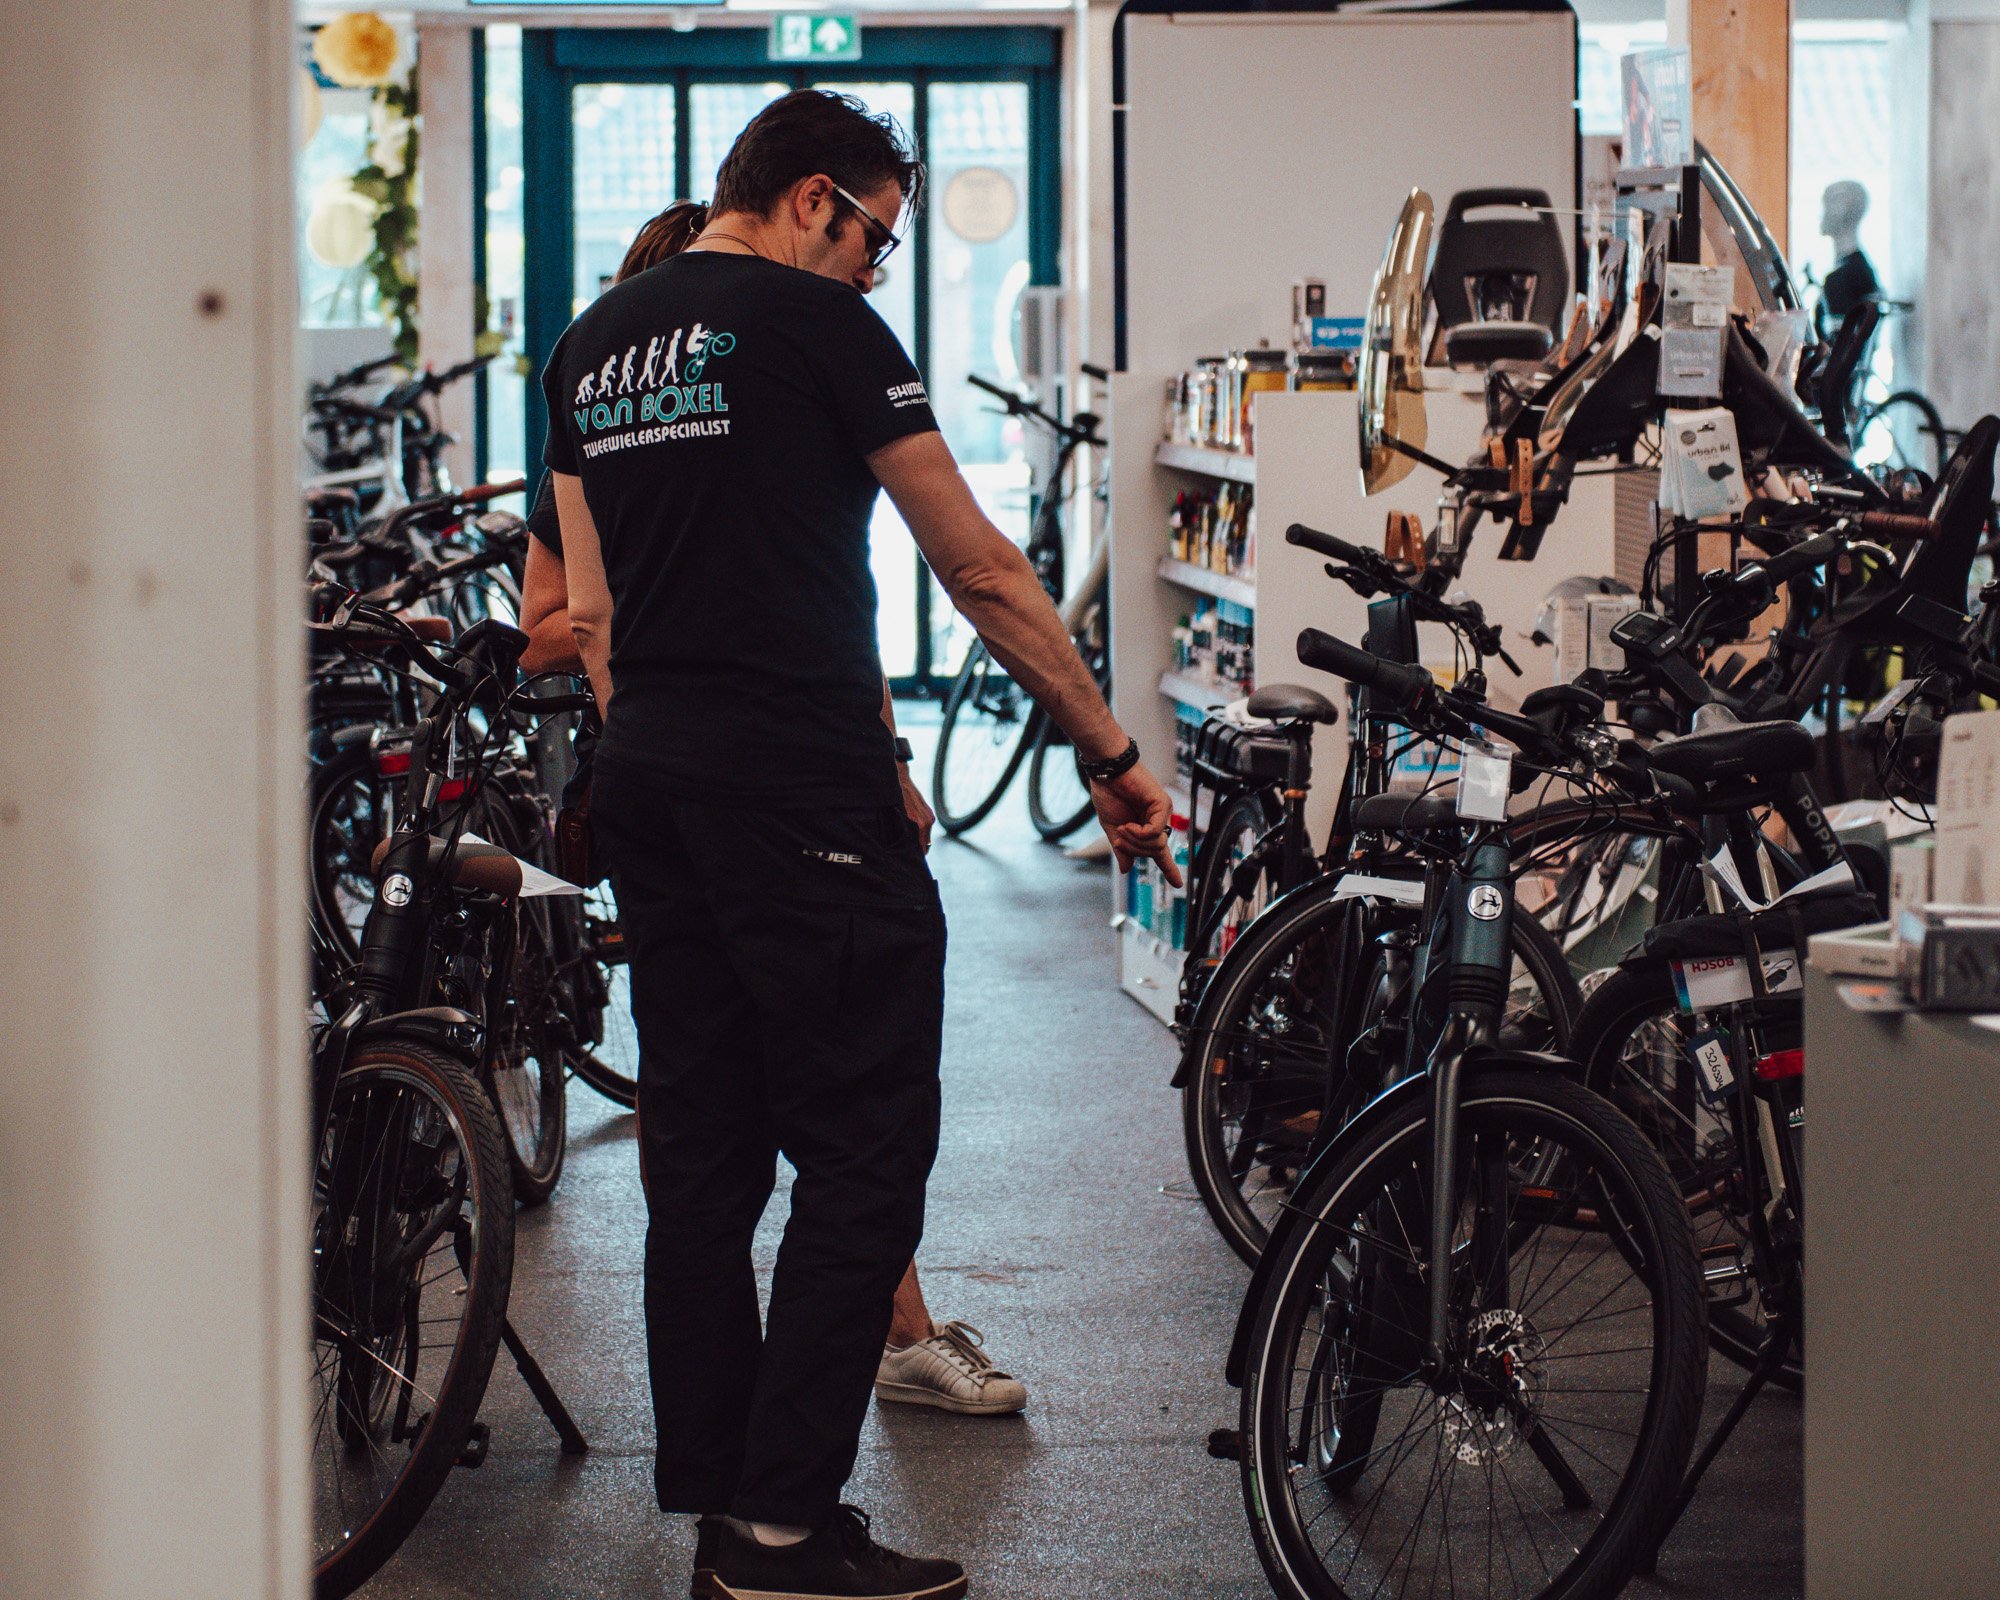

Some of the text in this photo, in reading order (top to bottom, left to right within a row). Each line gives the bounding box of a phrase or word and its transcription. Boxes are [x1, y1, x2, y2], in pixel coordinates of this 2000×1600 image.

[640, 383, 729, 425] BOXEL
[582, 419, 731, 460] TWEEWIELERSPECIALIST
[1691, 958, 1735, 973] BOSCH
[1705, 1047, 1725, 1089] 326334
